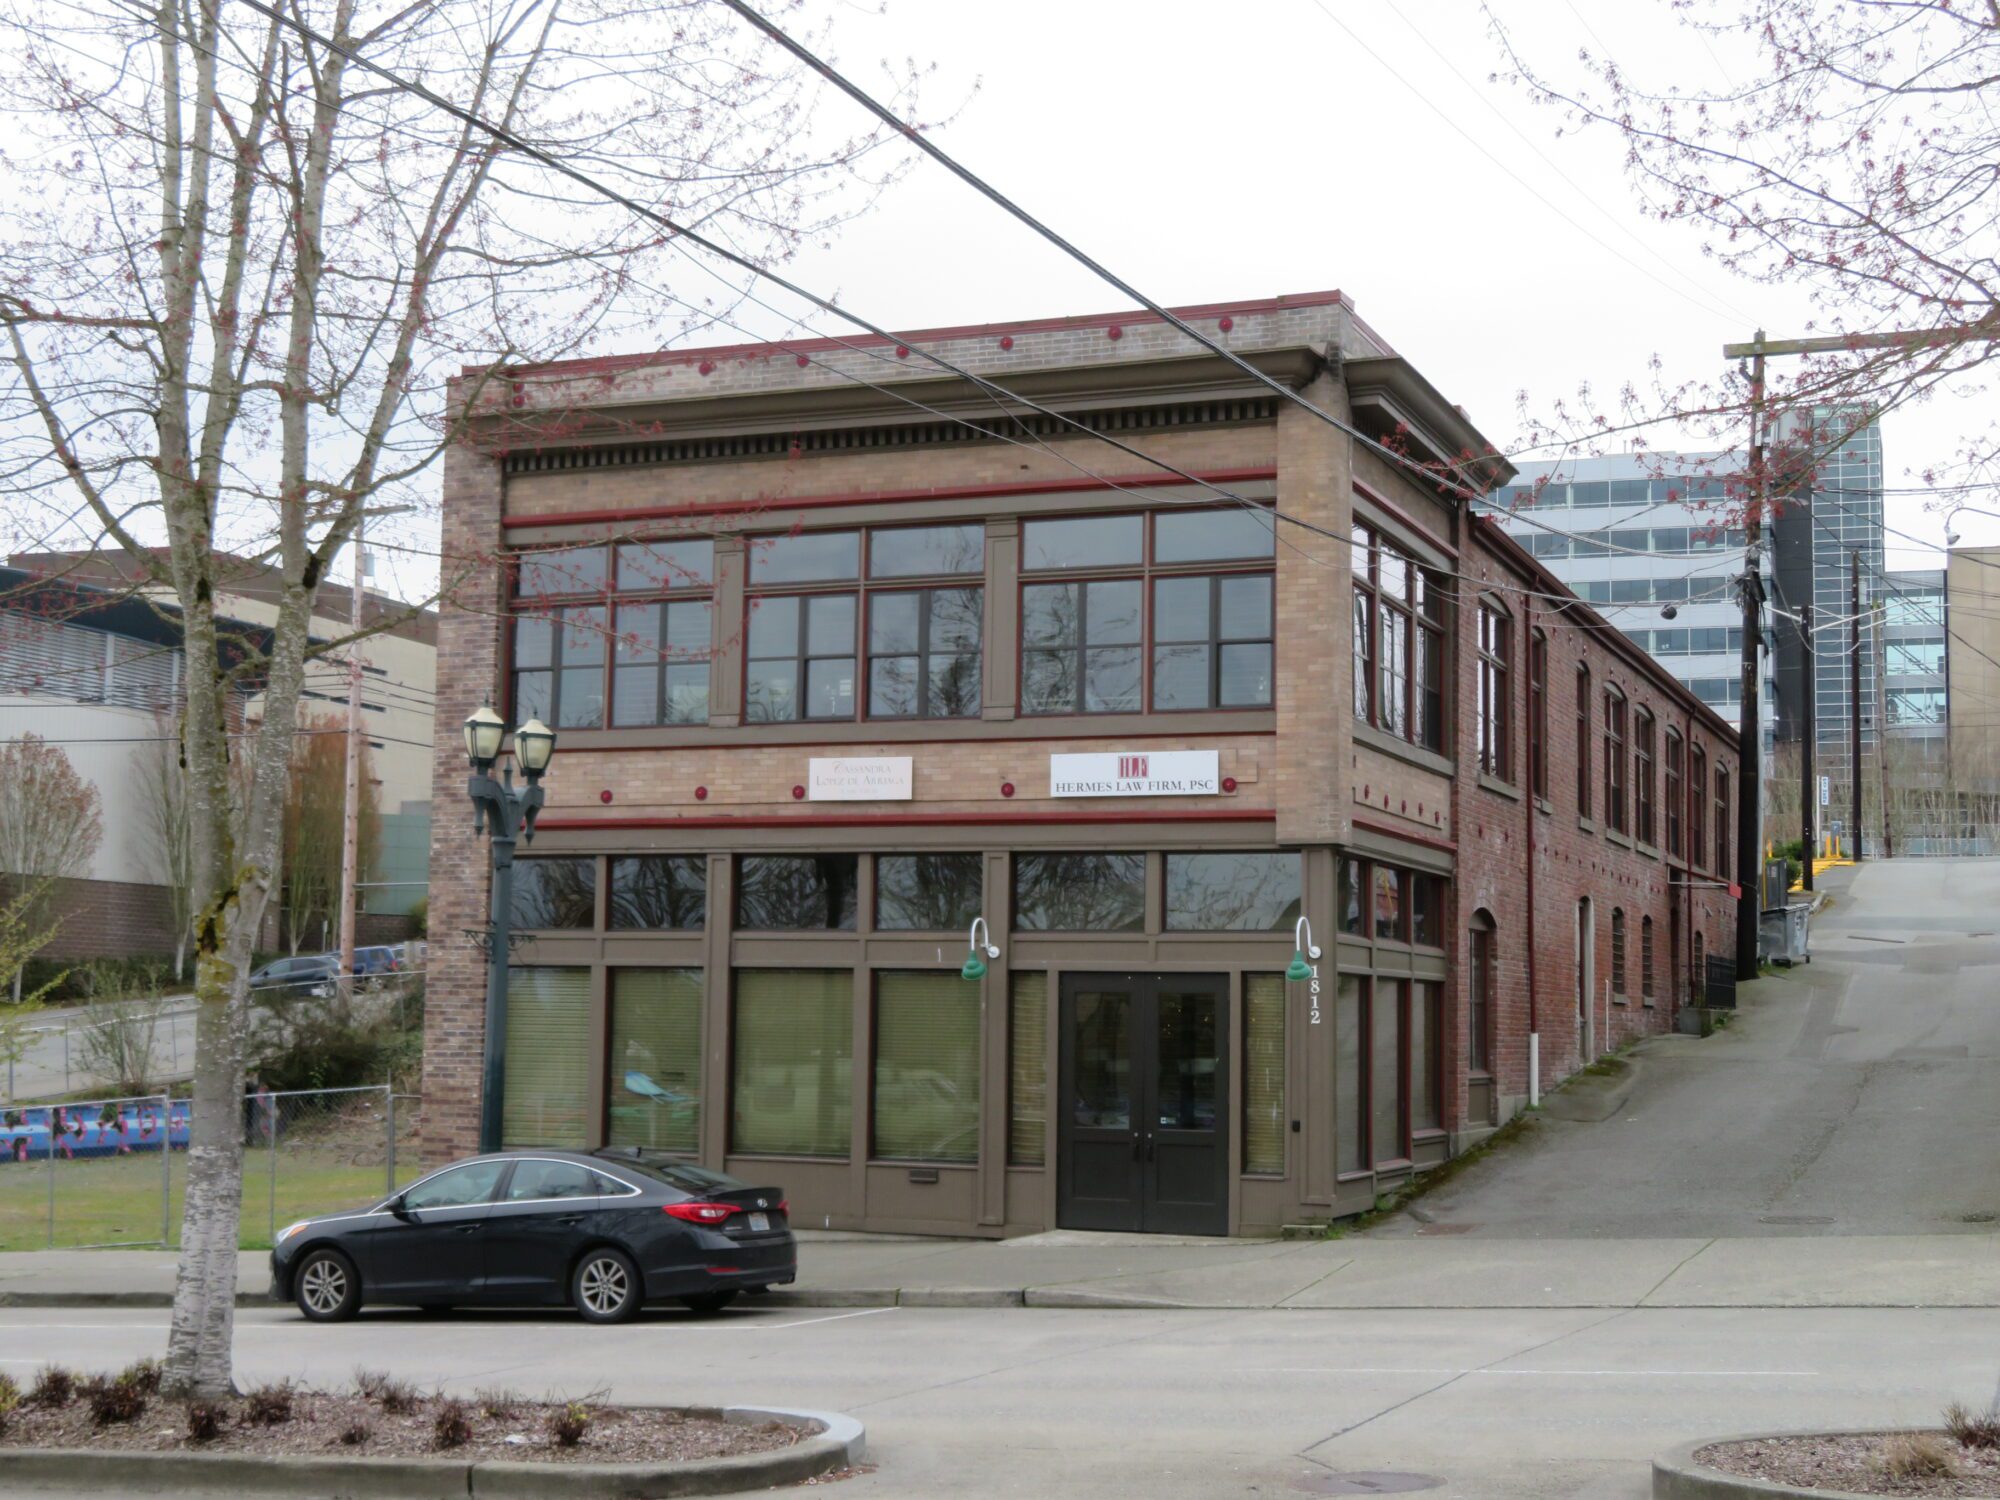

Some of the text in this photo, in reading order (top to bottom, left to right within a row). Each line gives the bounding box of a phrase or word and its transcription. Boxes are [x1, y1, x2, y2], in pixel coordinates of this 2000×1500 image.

[1055, 779, 1214, 793] HERMES LAW FIRM, PSC
[1311, 965, 1320, 1025] 1812
